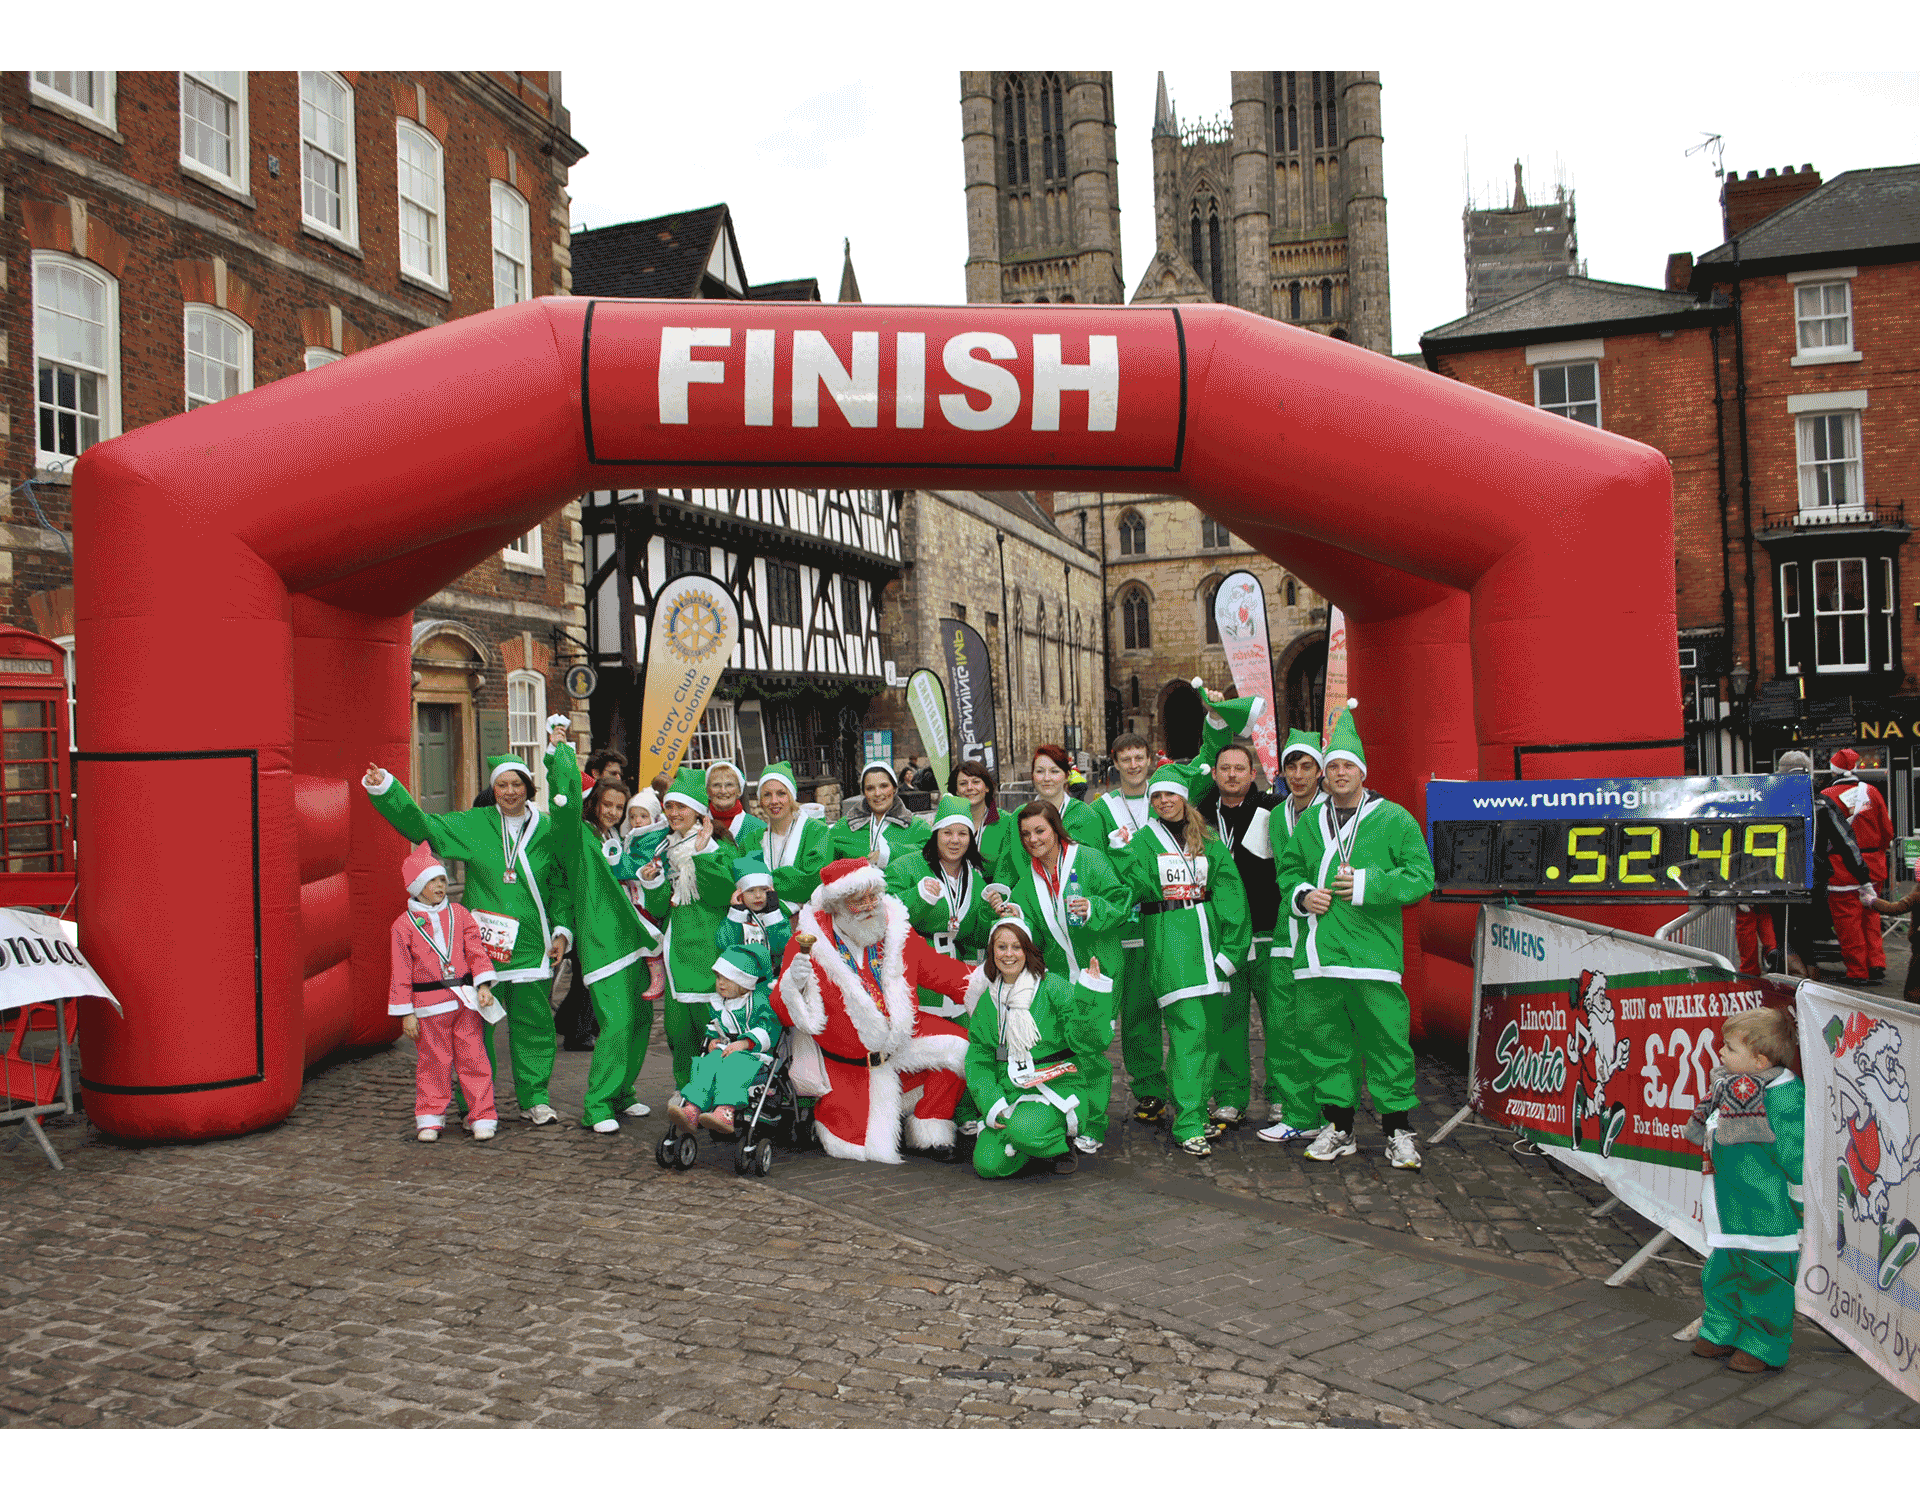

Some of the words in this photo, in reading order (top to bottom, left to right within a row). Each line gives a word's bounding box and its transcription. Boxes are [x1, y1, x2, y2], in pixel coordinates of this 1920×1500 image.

[658, 326, 1119, 432] FINISH
[649, 706, 679, 756] Rotary
[674, 668, 697, 703] Club
[676, 675, 711, 734] Colonia
[1473, 787, 1763, 809] www.runningimo.uk
[1166, 868, 1186, 882] 641
[0, 936, 87, 969] nia
[1491, 923, 1545, 962] SIEMENS
[1520, 1001, 1567, 1031] Lincoln
[1620, 998, 1646, 1020] RUN
[1649, 1003, 1662, 1020] or
[1663, 993, 1708, 1019] WALK
[1708, 992, 1721, 1017] &
[1492, 1019, 1567, 1093] Santa
[1546, 1103, 1566, 1123] 2011
[1632, 1114, 1651, 1136] For
[1652, 1117, 1670, 1138] the
[1804, 1264, 1890, 1344] Organised
